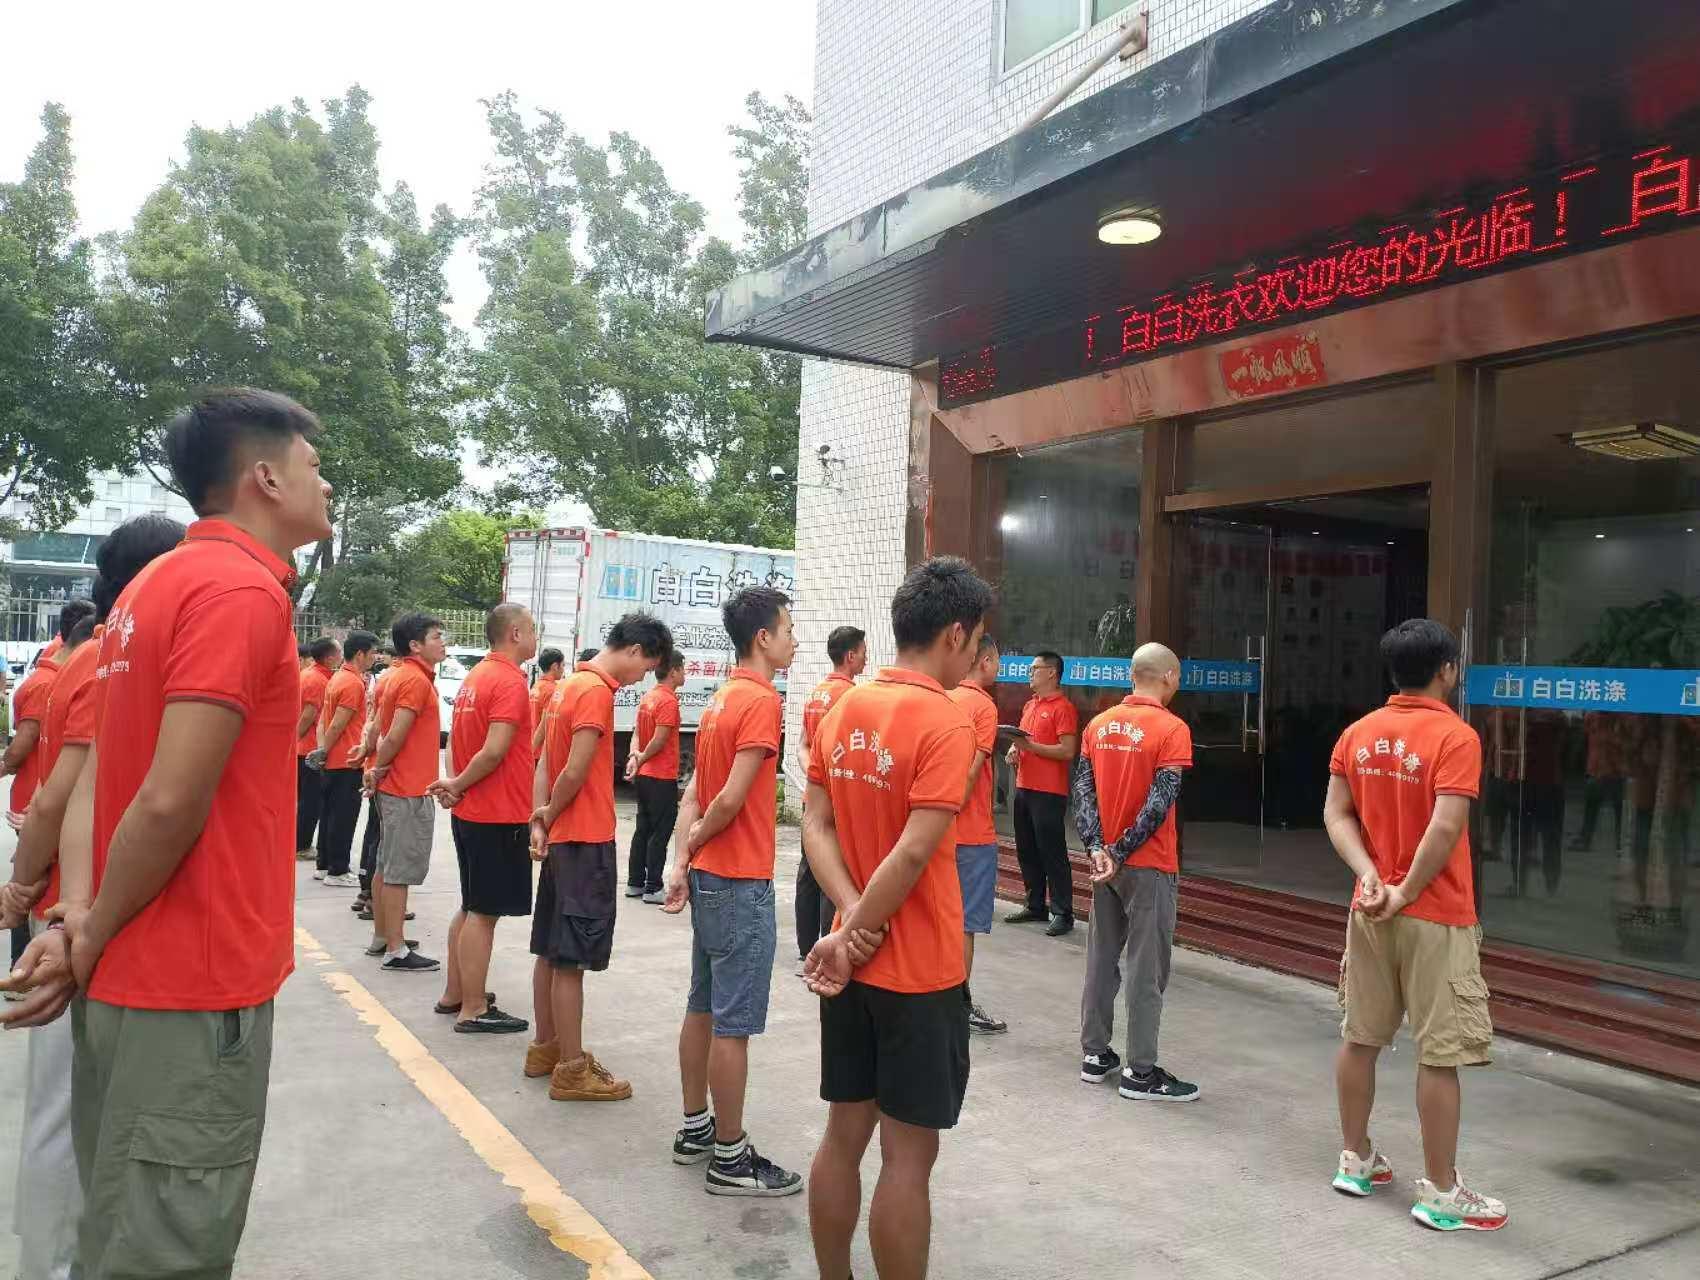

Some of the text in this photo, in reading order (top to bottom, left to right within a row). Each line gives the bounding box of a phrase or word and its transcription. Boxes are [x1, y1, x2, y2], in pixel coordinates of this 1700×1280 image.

[1008, 662, 1032, 677] 白白
[1207, 670, 1253, 686] 白白洗涤
[1532, 677, 1627, 702] 白白洗涤
